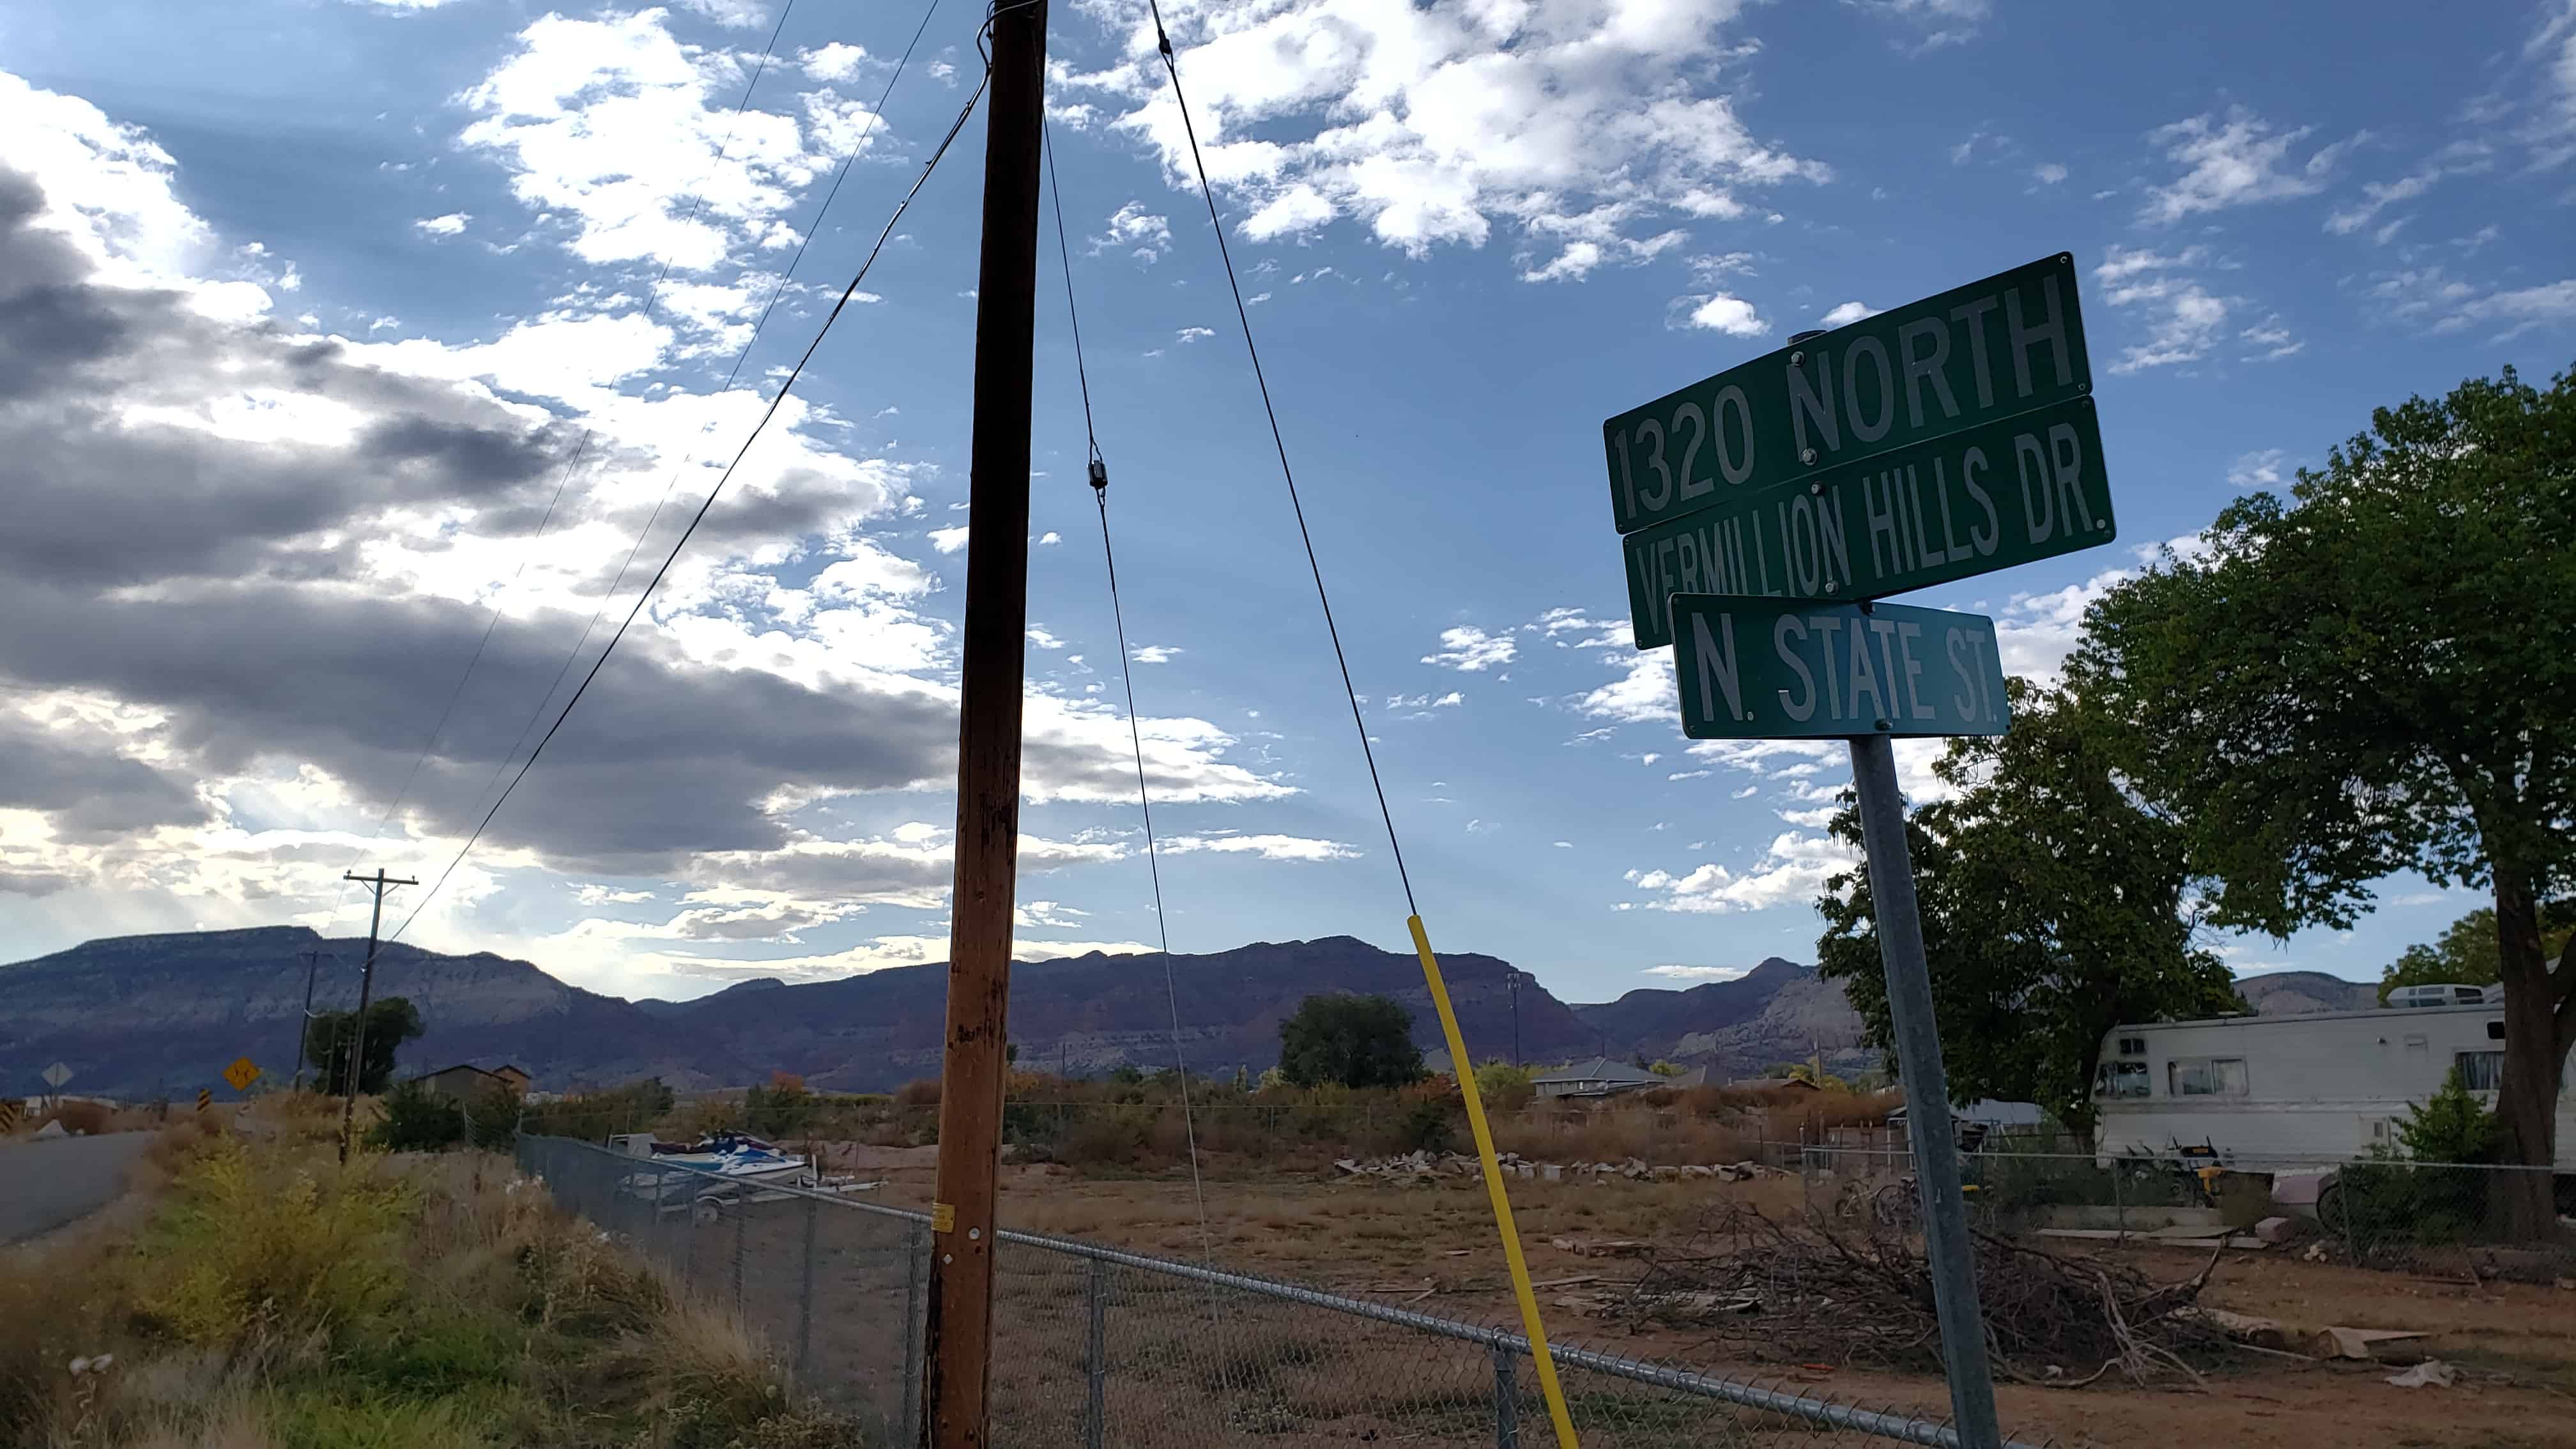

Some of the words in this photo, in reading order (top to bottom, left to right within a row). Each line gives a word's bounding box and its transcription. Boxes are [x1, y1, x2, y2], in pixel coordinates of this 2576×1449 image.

[1613, 385, 1755, 518] 1320
[1786, 274, 2073, 463] NORTH
[1862, 446, 2000, 580] HILLS
[2014, 422, 2107, 544] DR.
[1692, 612, 1755, 723] N.
[1775, 615, 1935, 722] STATE
[1945, 627, 1998, 723] ST.
